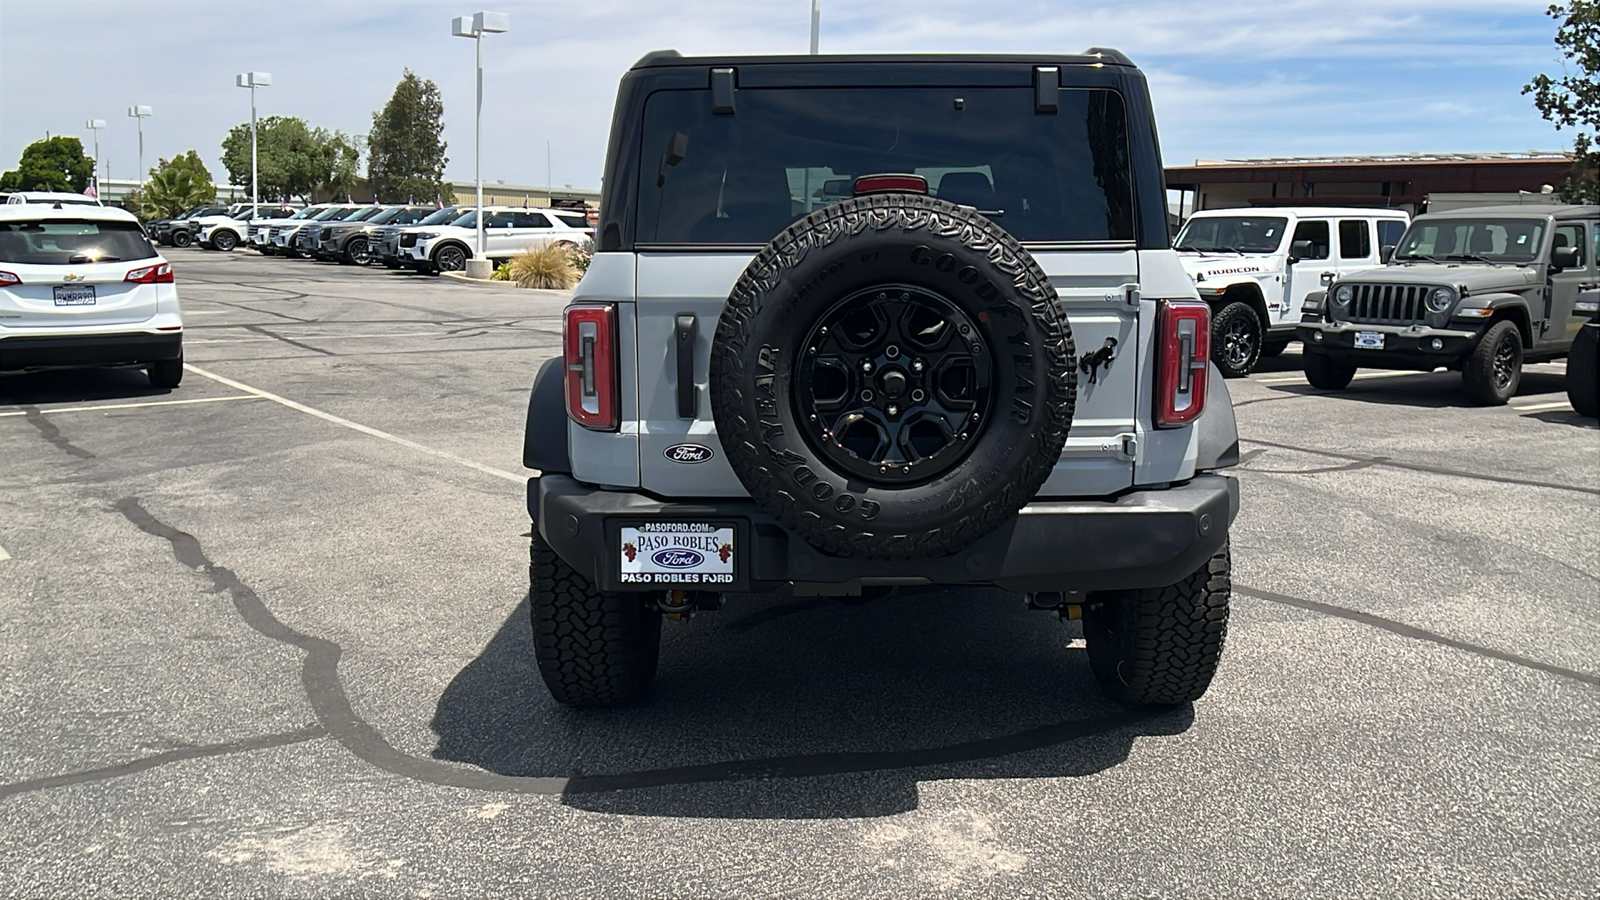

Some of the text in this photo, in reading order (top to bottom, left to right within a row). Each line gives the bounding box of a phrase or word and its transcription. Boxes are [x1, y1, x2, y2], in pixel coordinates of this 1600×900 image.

[1207, 266, 1260, 275] RUBICON
[754, 342, 881, 520] GOOD YEAR
[673, 447, 704, 460] Ford
[645, 523, 709, 532] PASOFORD.COM
[638, 536, 719, 552] PASO ROBLES
[662, 552, 694, 565] Ford
[622, 574, 652, 582] PASO
[655, 574, 698, 582] ROBLES
